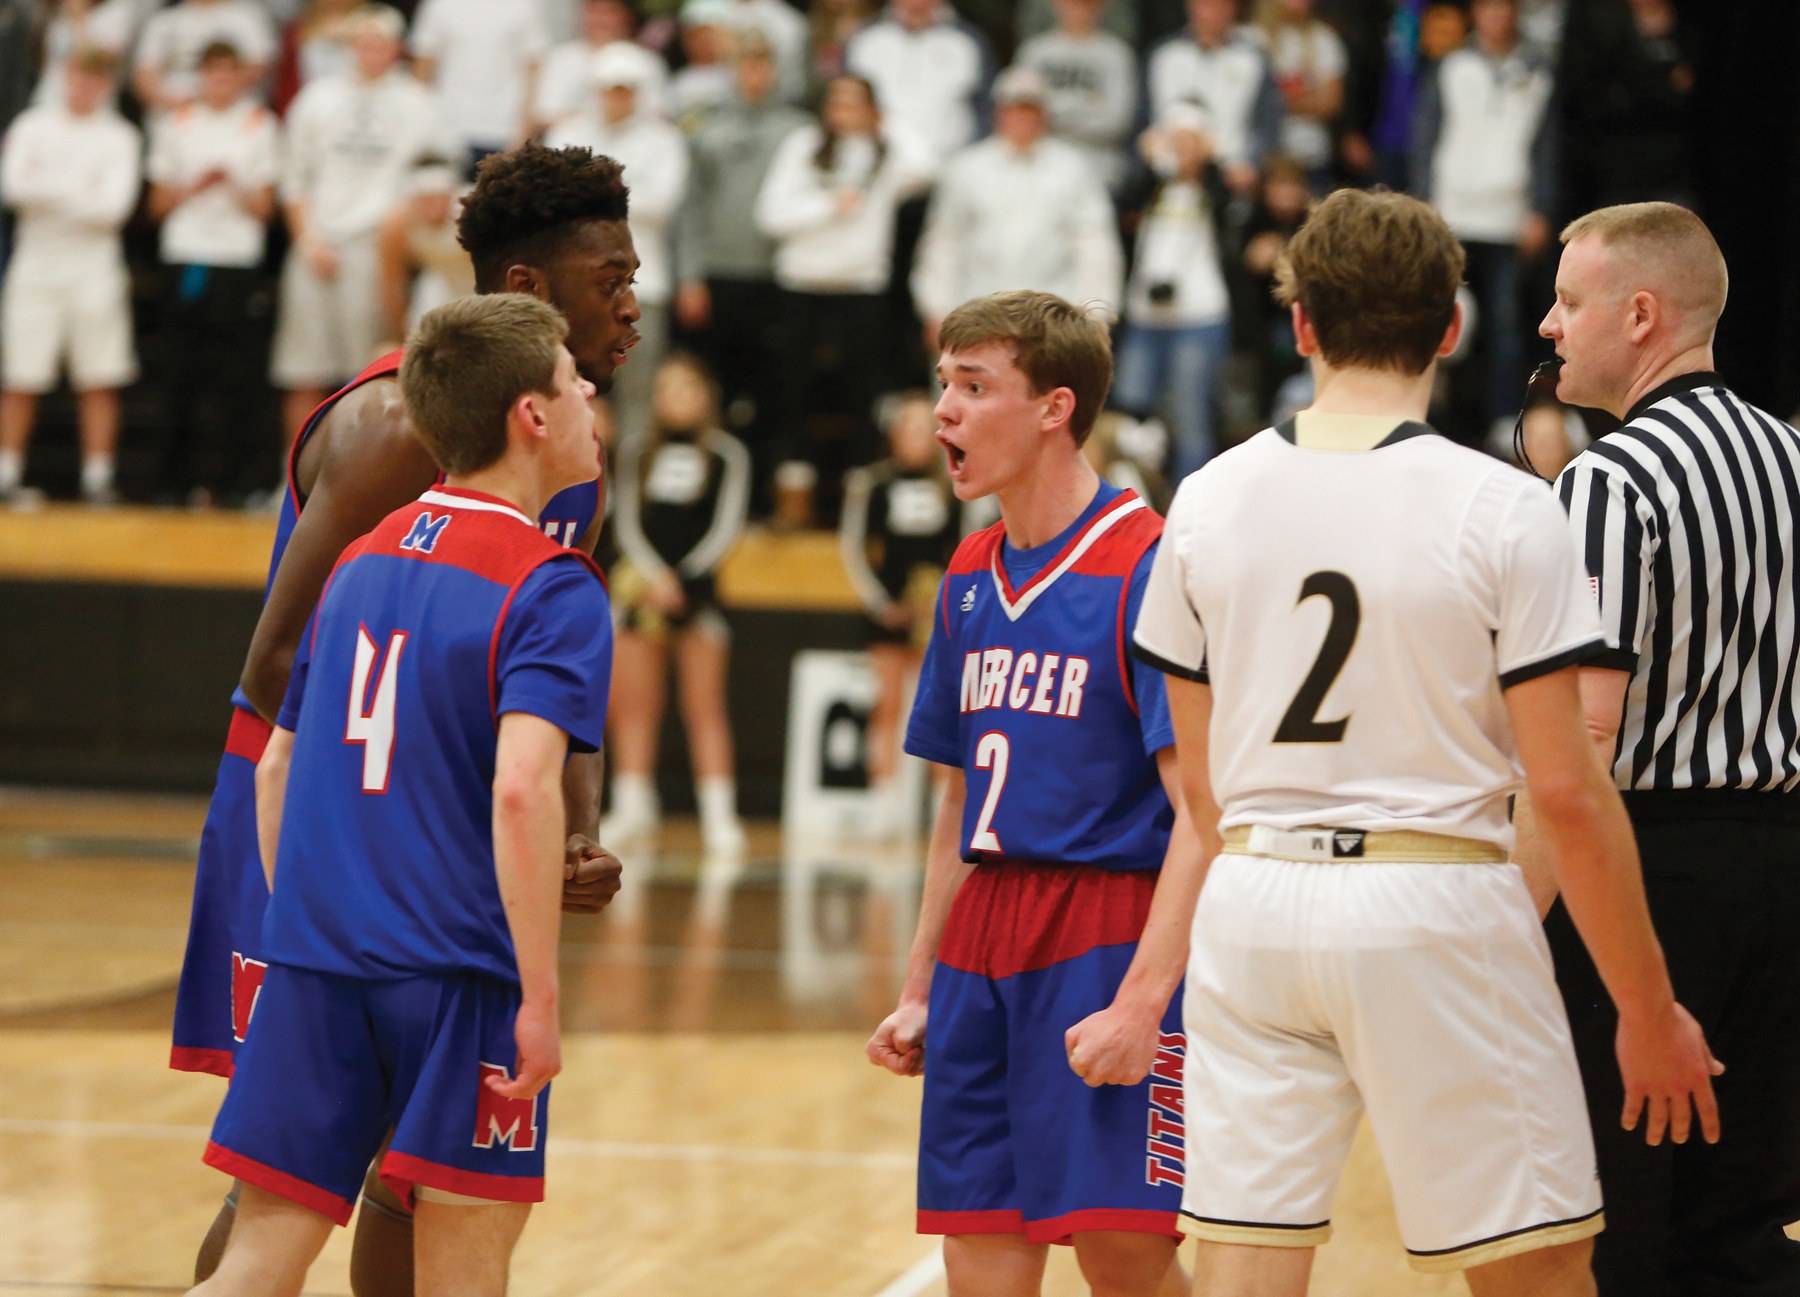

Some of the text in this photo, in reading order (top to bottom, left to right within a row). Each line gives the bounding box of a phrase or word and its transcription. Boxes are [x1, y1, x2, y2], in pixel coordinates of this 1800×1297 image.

[400, 511, 453, 554] M
[342, 620, 411, 795] 4
[960, 646, 1090, 719] MERCER
[1269, 567, 1363, 746] 2
[969, 729, 1011, 855] 2
[471, 1060, 538, 1152] M
